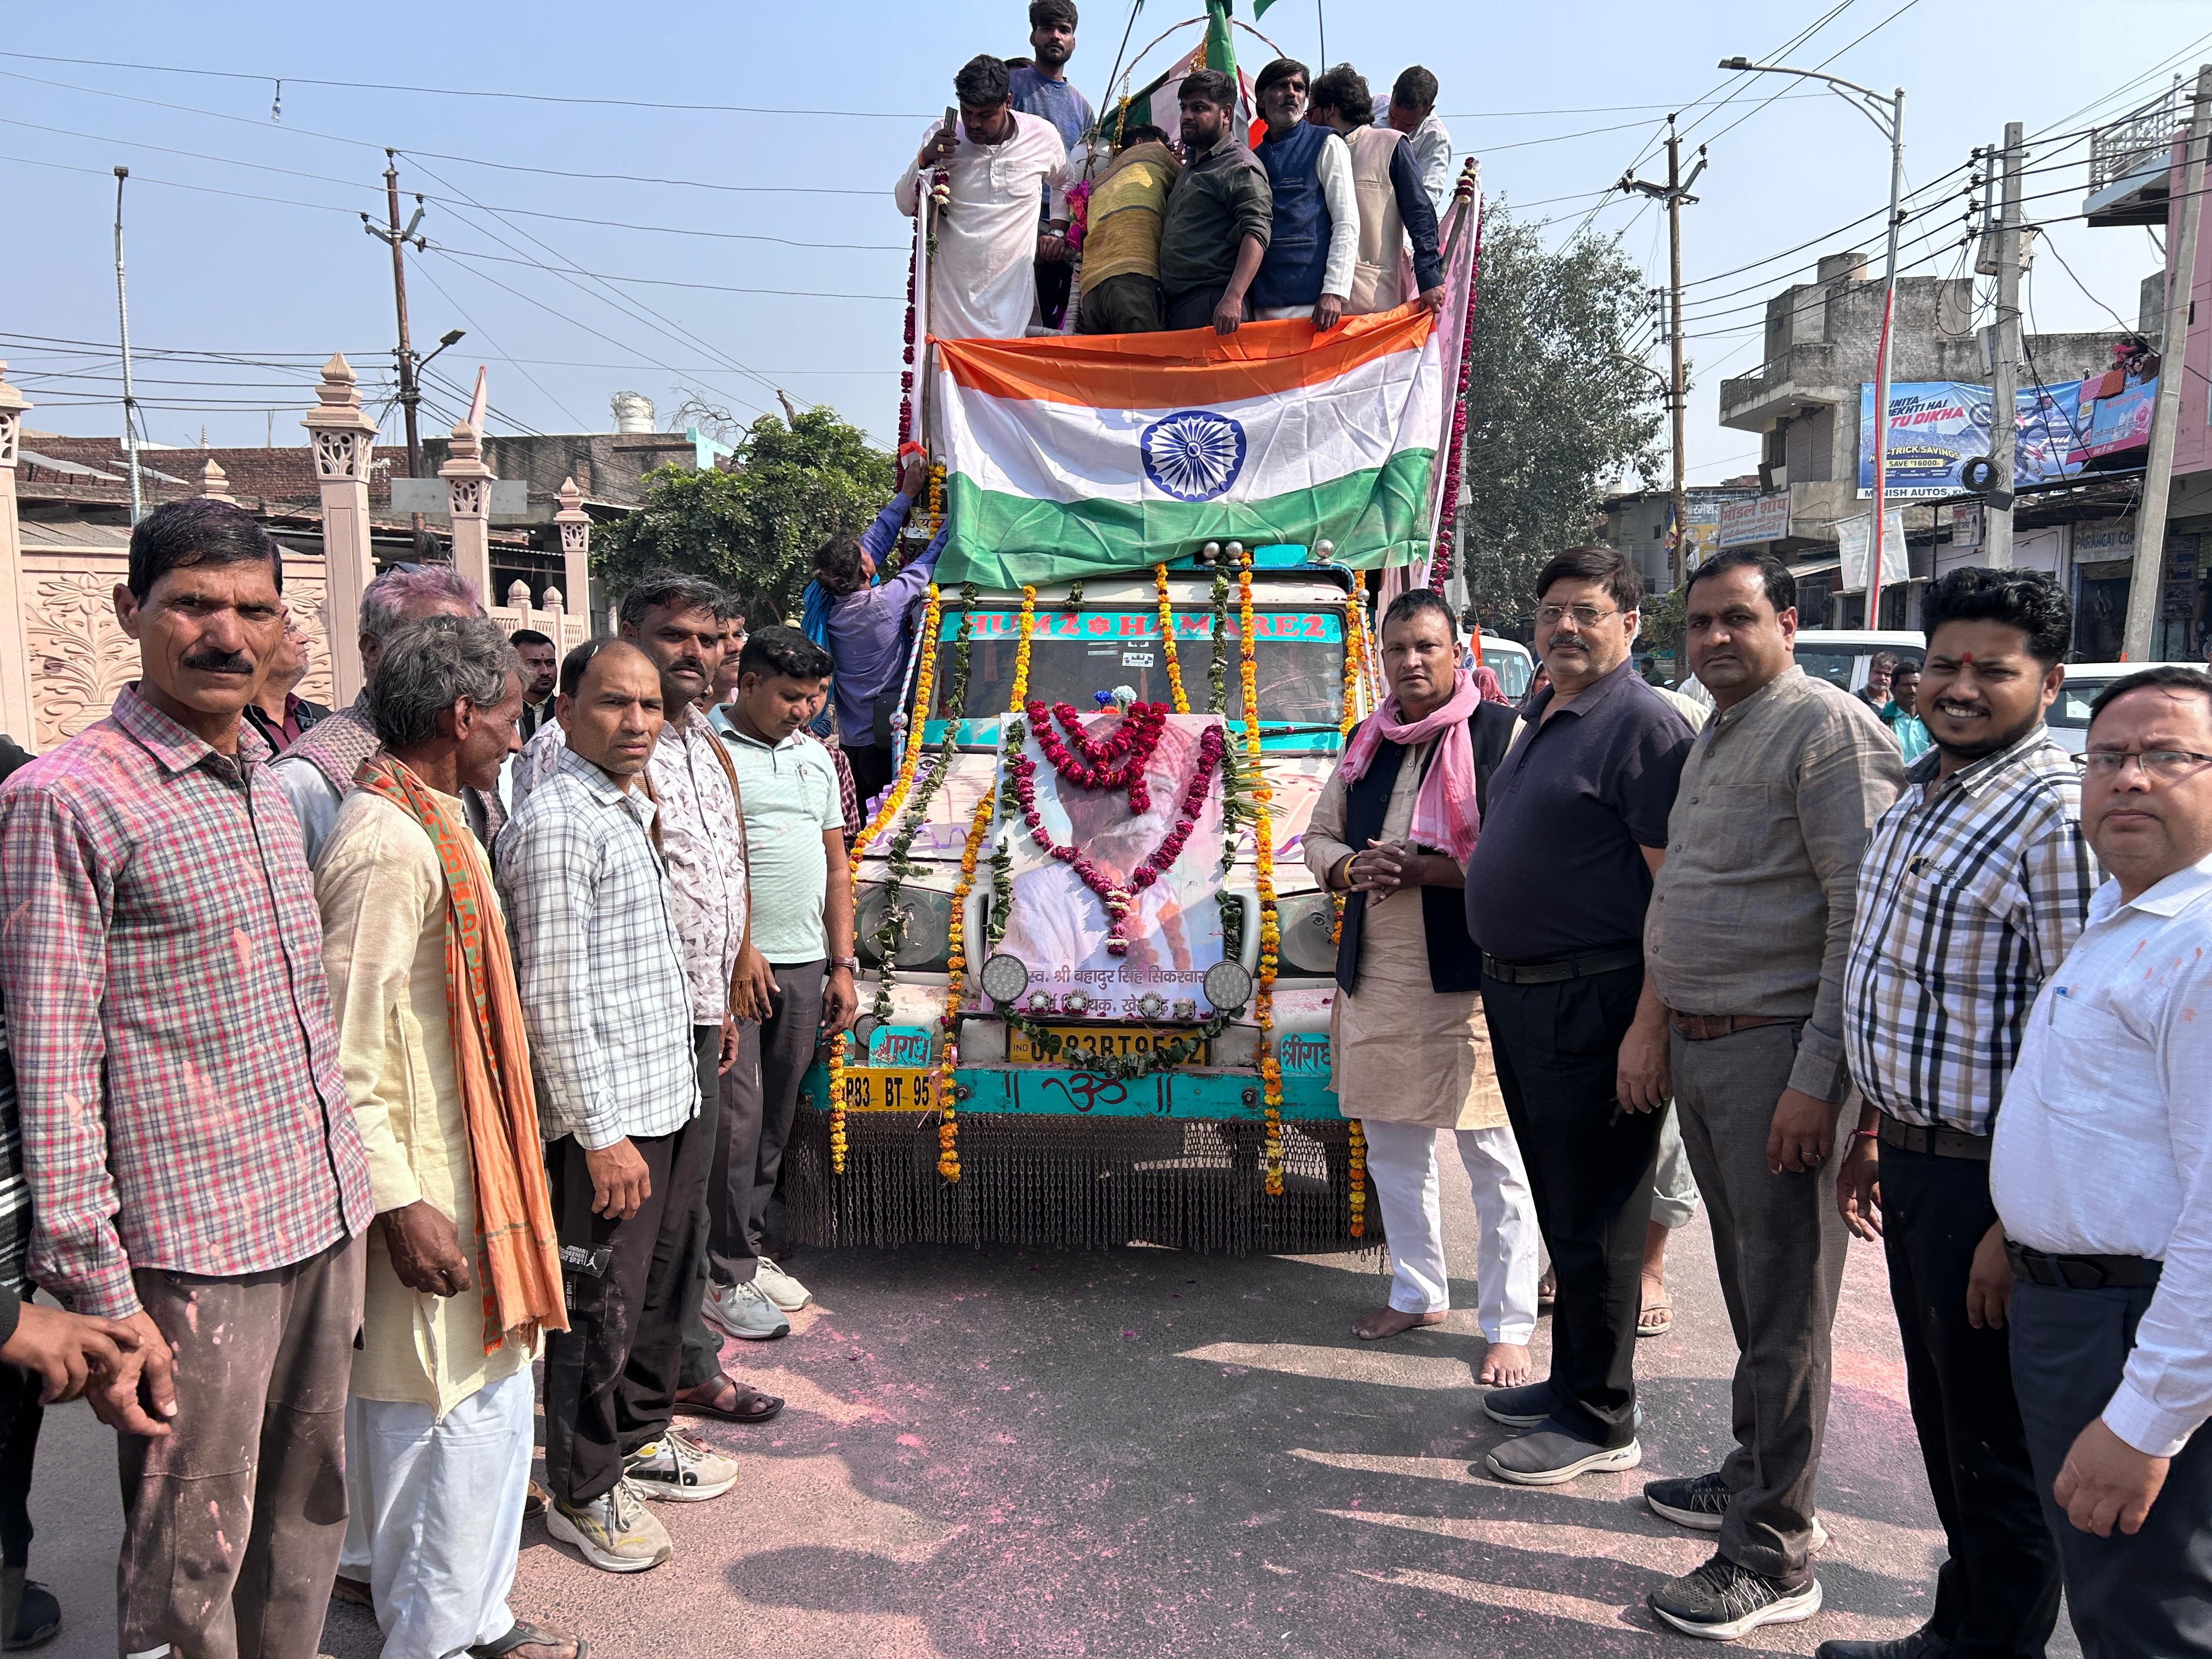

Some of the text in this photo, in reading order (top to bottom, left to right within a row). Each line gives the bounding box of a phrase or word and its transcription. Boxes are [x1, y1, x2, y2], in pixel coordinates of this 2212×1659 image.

[1888, 396, 1919, 409] UNIYA
[1891, 416, 1912, 429] TU
[1868, 445, 1960, 462] H-TRICK SAVINGS
[1865, 489, 1908, 498] MNISH
[1722, 504, 1756, 521] मॉडल
[1756, 515, 1765, 523] की
[1028, 964, 1206, 990] स्व. श्री बहादुर सिंह सिकरवार
[1013, 1043, 1028, 1052] IND
[885, 1076, 903, 1107] BT
[566, 1245, 586, 1254] JORDAN
